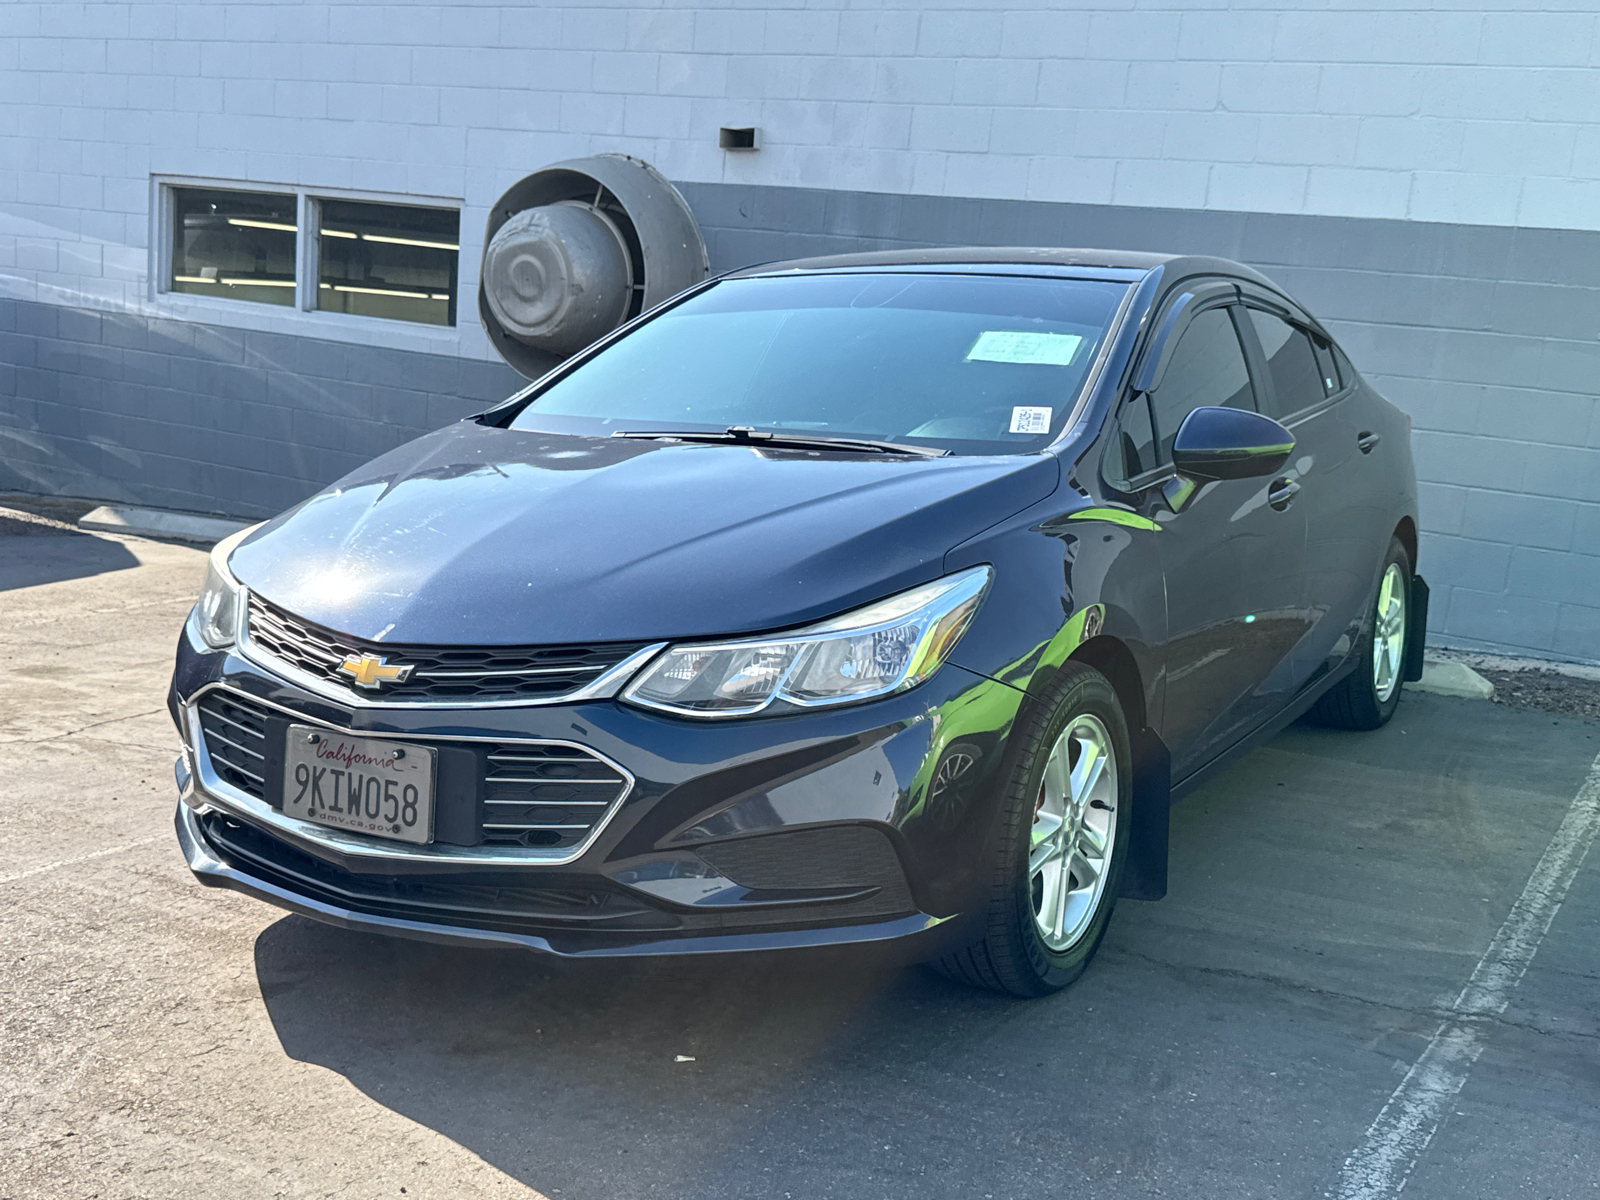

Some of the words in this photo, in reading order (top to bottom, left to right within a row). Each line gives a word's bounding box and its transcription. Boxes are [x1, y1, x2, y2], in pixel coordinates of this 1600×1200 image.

[316, 738, 405, 772] California
[293, 763, 419, 827] 9KIW058
[319, 812, 393, 832] dmv.ca.gov
